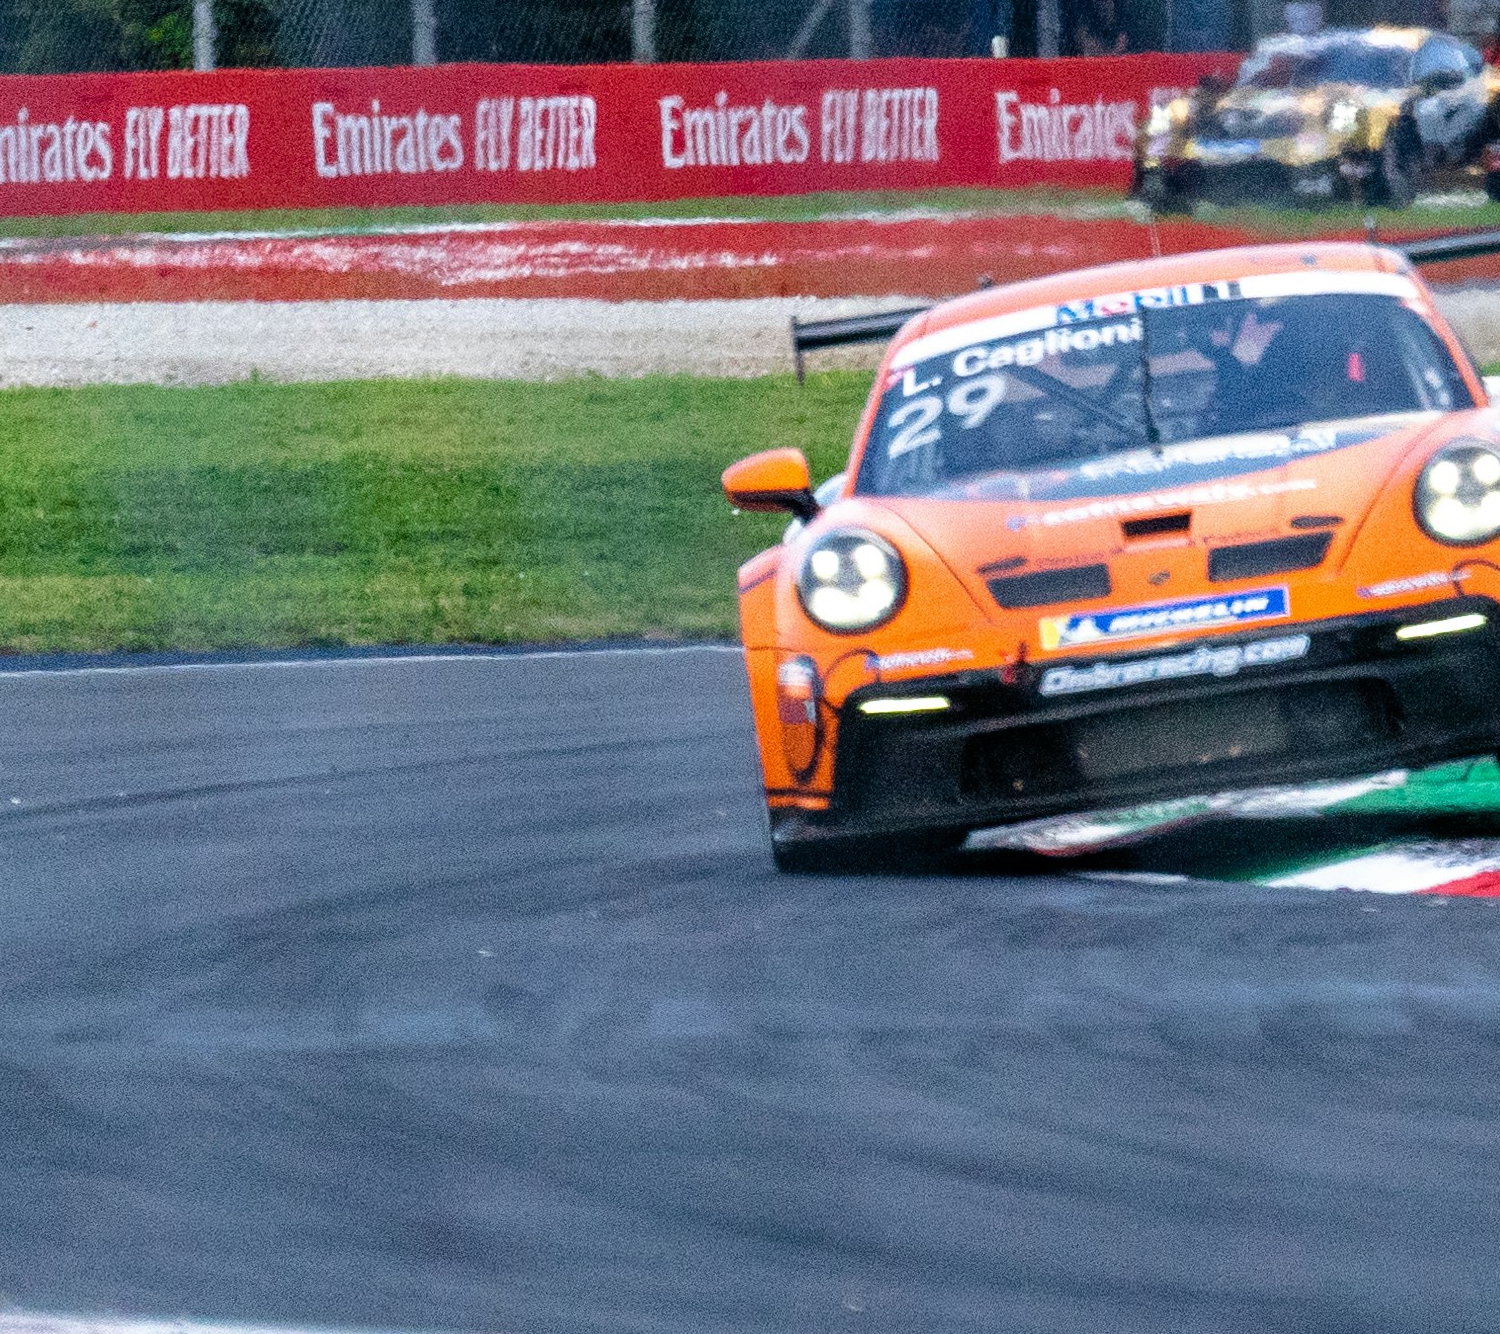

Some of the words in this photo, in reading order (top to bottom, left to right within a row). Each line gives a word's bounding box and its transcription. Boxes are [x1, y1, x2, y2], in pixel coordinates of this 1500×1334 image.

[124, 105, 162, 180] FLY
[167, 103, 250, 180] BETTER
[312, 99, 463, 177] Emirates
[475, 98, 515, 172] FLY
[518, 94, 596, 172] BETTER
[659, 90, 809, 167] Emirates
[821, 89, 859, 162] FLY
[862, 87, 938, 162] BETTER
[995, 88, 1138, 162] Emirates
[902, 368, 944, 397] L.
[953, 317, 1145, 377] Caglioni
[887, 374, 1005, 459] 29
